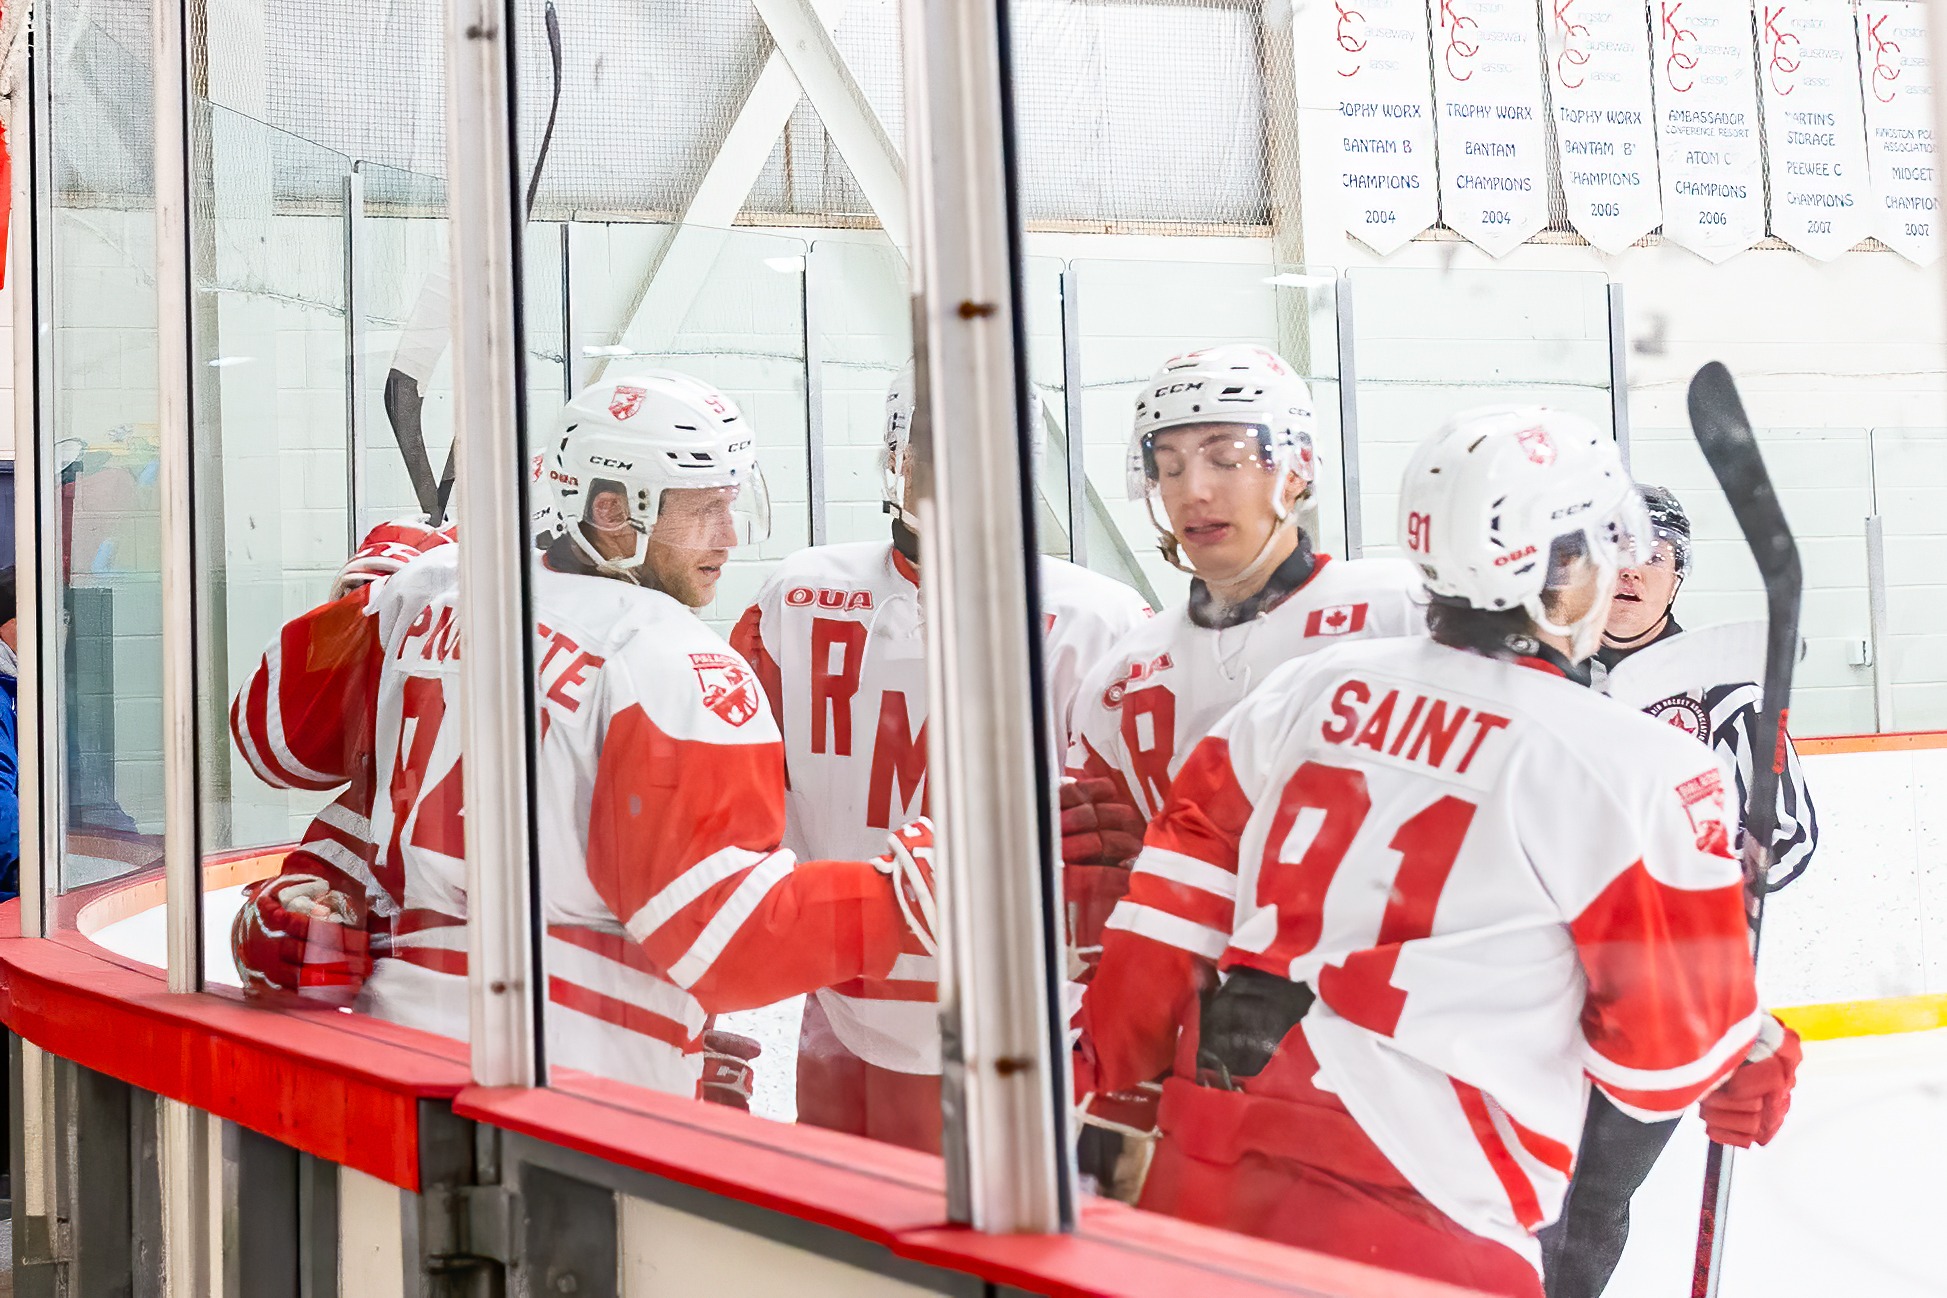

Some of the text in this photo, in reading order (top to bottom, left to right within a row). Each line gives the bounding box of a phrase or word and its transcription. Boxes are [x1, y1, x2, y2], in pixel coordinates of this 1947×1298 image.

[1339, 102, 1421, 119] ROPHY WORX
[1446, 103, 1533, 120] TROPHY WORX
[1560, 107, 1642, 125] TROPHY WORX
[1668, 110, 1745, 125] AMBASSADOR
[1343, 138, 1397, 153] BANTAM
[1787, 131, 1836, 147] STORAGE
[1465, 141, 1515, 157] BANTAM
[1565, 140, 1614, 155] BANTAM
[1686, 151, 1719, 165] ATOM
[1786, 161, 1842, 177] PEEWEE C
[1892, 167, 1935, 182] MIDGET
[1343, 174, 1420, 189] CHAMPIONS
[1457, 175, 1532, 191] CHAMPIONS
[1675, 181, 1747, 199] CHAMPIONS
[1786, 192, 1854, 208] CHAMPIONS
[1365, 210, 1396, 224] 2004
[1482, 211, 1511, 224] 2004
[1591, 203, 1620, 216] 2005
[1699, 211, 1727, 226] 2006
[1807, 220, 1832, 234] 2007
[1155, 382, 1204, 398] CCM
[589, 455, 633, 471] CCM
[1551, 499, 1594, 520] CCM
[1408, 511, 1431, 554] 91
[1493, 545, 1538, 568] OUA
[785, 586, 874, 611] OUA
[1321, 679, 1513, 774] SAINT
[1662, 698, 1690, 707] HOCKEY
[1690, 702, 1709, 741] ASSOCIATIO
[1217, 760, 1478, 1039] 91
